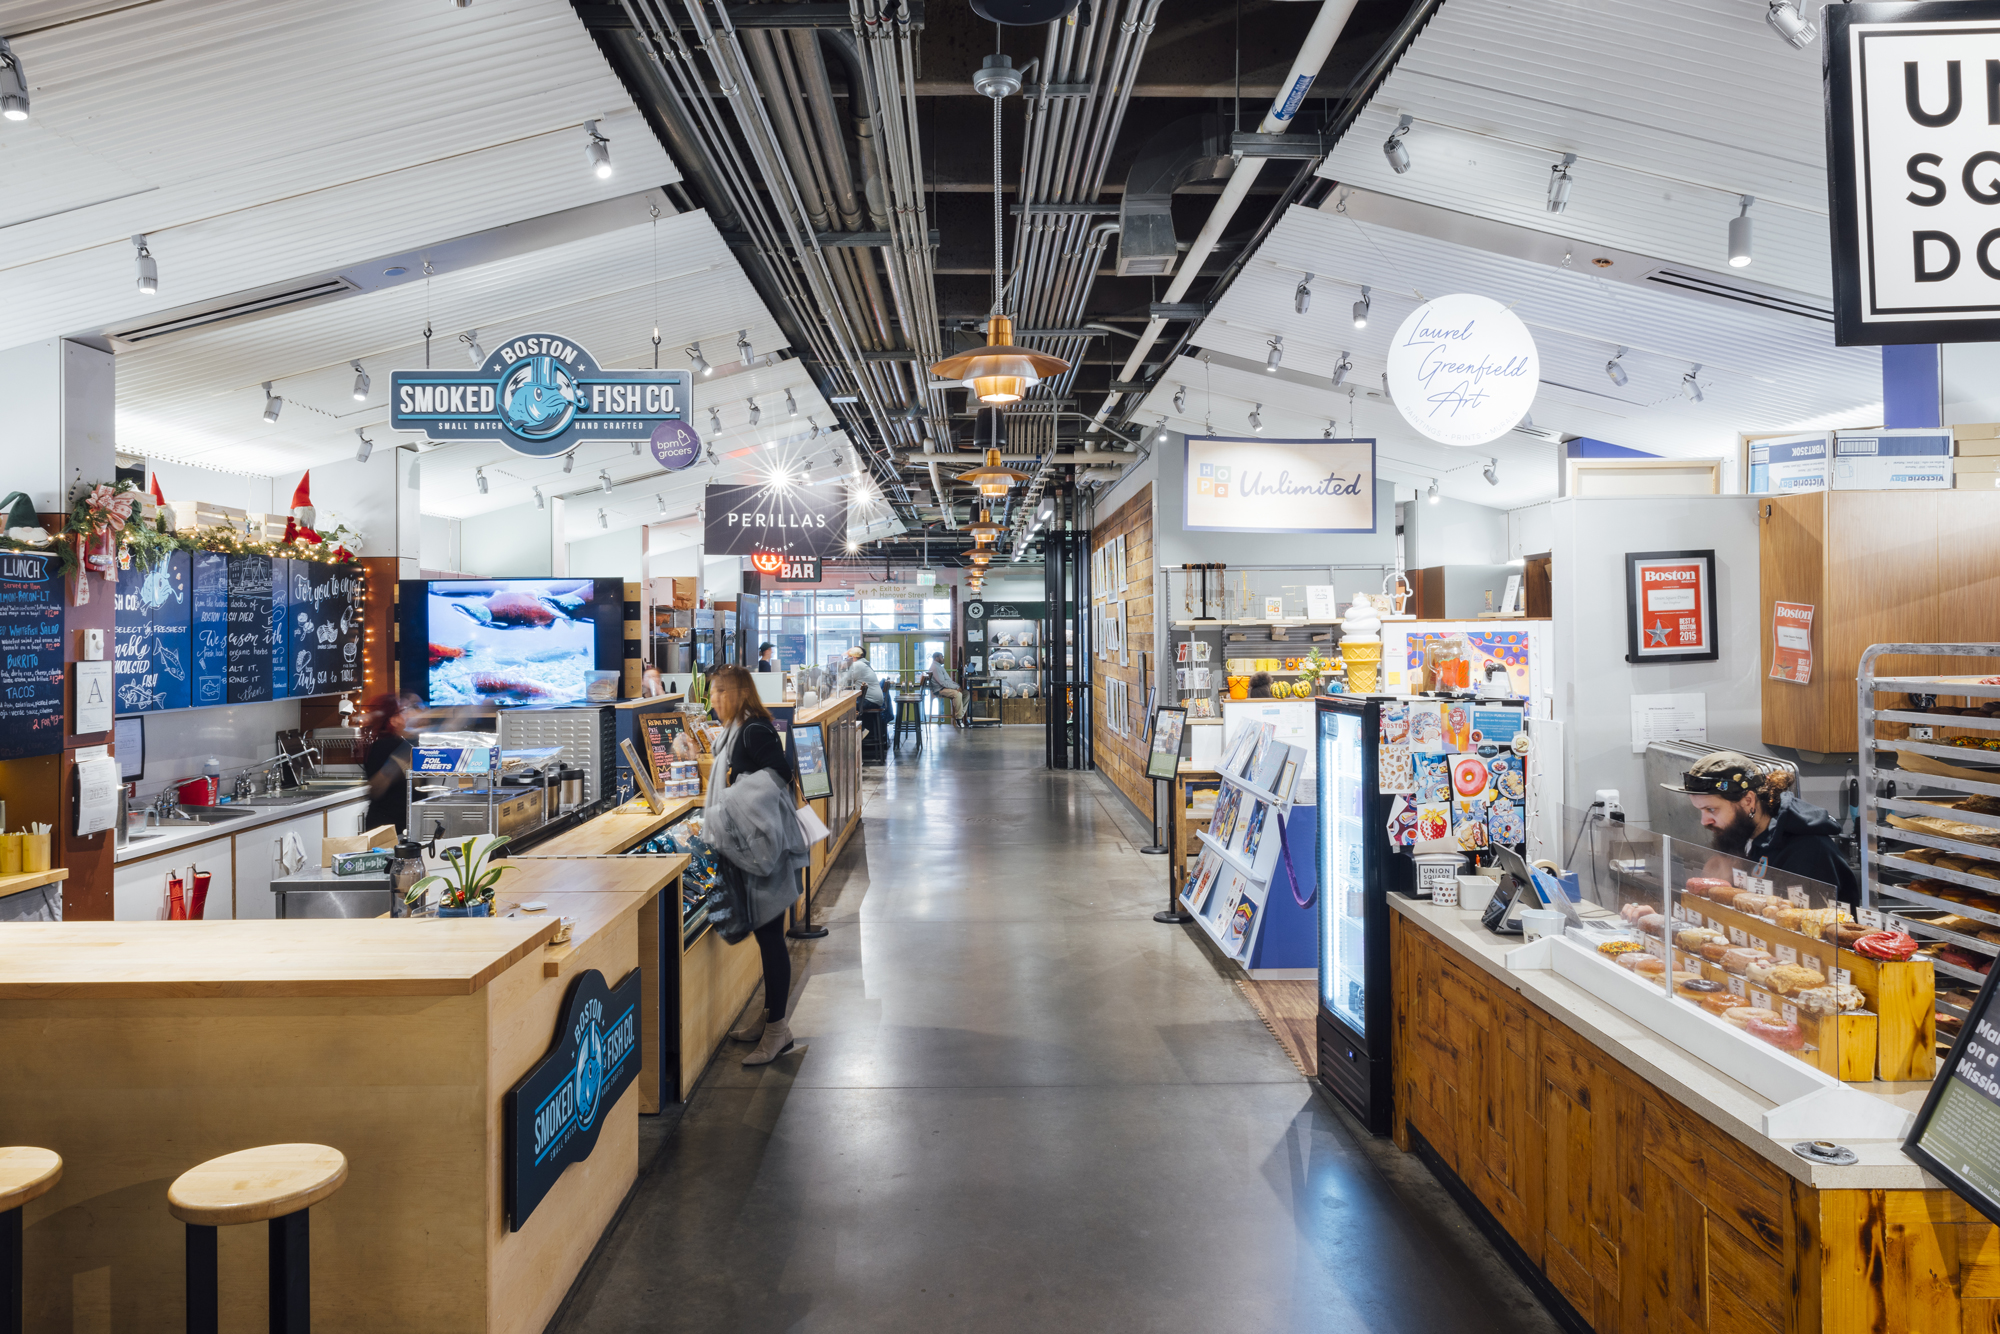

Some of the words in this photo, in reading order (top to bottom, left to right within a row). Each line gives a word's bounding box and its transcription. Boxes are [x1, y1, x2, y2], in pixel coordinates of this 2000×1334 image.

[1904, 59, 2000, 128] U
[1403, 310, 1475, 347] Laurel
[500, 338, 578, 365] BOSTON
[1418, 344, 1528, 390] Greenfield
[400, 385, 494, 414] SMOKED
[592, 385, 641, 413] FISH
[645, 385, 681, 413] CO.
[1427, 380, 1490, 418] Art
[438, 422, 468, 430] SMALL
[474, 422, 503, 430] BATCH
[575, 422, 599, 430] HAND
[603, 422, 644, 430] CRAFTED
[1404, 405, 1442, 437] PAINTINGS
[1451, 432, 1482, 441] PRINTS
[1489, 410, 1519, 435] MURALS
[657, 440, 680, 453] bpm
[658, 447, 693, 459] grocers
[1792, 444, 1825, 457] VBRT350K
[1239, 470, 1361, 498] Unlimited
[1793, 478, 1824, 487] Victoria
[728, 513, 826, 528] PERILLAS
[754, 541, 794, 553] KITCHEN
[3, 559, 40, 579] LUNCH
[780, 564, 815, 578] BAR
[1644, 570, 1696, 582] Boston
[294, 574, 313, 602] For
[314, 580, 330, 610] you
[330, 574, 340, 596] to
[340, 574, 361, 608] enjoy
[230, 599, 247, 608] docks
[250, 600, 258, 611] of
[816, 600, 850, 612] Hand
[201, 612, 220, 622] BOSTON
[222, 612, 238, 622] FISH
[238, 612, 254, 622] PIER
[1777, 606, 1812, 620] Boston
[40, 622, 60, 636] SALAD
[115, 626, 141, 634] SELECT
[154, 626, 187, 634] FRESHEST
[1680, 632, 1696, 640] 2015
[254, 647, 268, 656] herbs
[7, 654, 39, 670] BURRITO
[222, 664, 244, 672] SALT
[142, 673, 158, 688] FISH
[221, 676, 248, 684] BRINE
[293, 671, 316, 694] Truly
[318, 672, 327, 684] SEA
[330, 671, 338, 682] to
[6, 685, 35, 698] TACOS
[88, 678, 104, 704] A
[32, 718, 40, 730] 2
[41, 717, 52, 729] FOR
[90, 787, 109, 800] 2024
[574, 998, 603, 1044] BOSTON
[607, 1030, 624, 1070] FISH
[624, 1014, 635, 1050] CO.
[1967, 1041, 1984, 1056] on
[1986, 1052, 1999, 1068] a
[601, 1083, 610, 1098] HAND
[610, 1064, 625, 1087] CRAFTED
[535, 1080, 574, 1155] SMOKED
[550, 1141, 564, 1162] SMALL
[564, 1125, 577, 1144] BATCH
[1968, 1170, 1988, 1189] BOSTON
